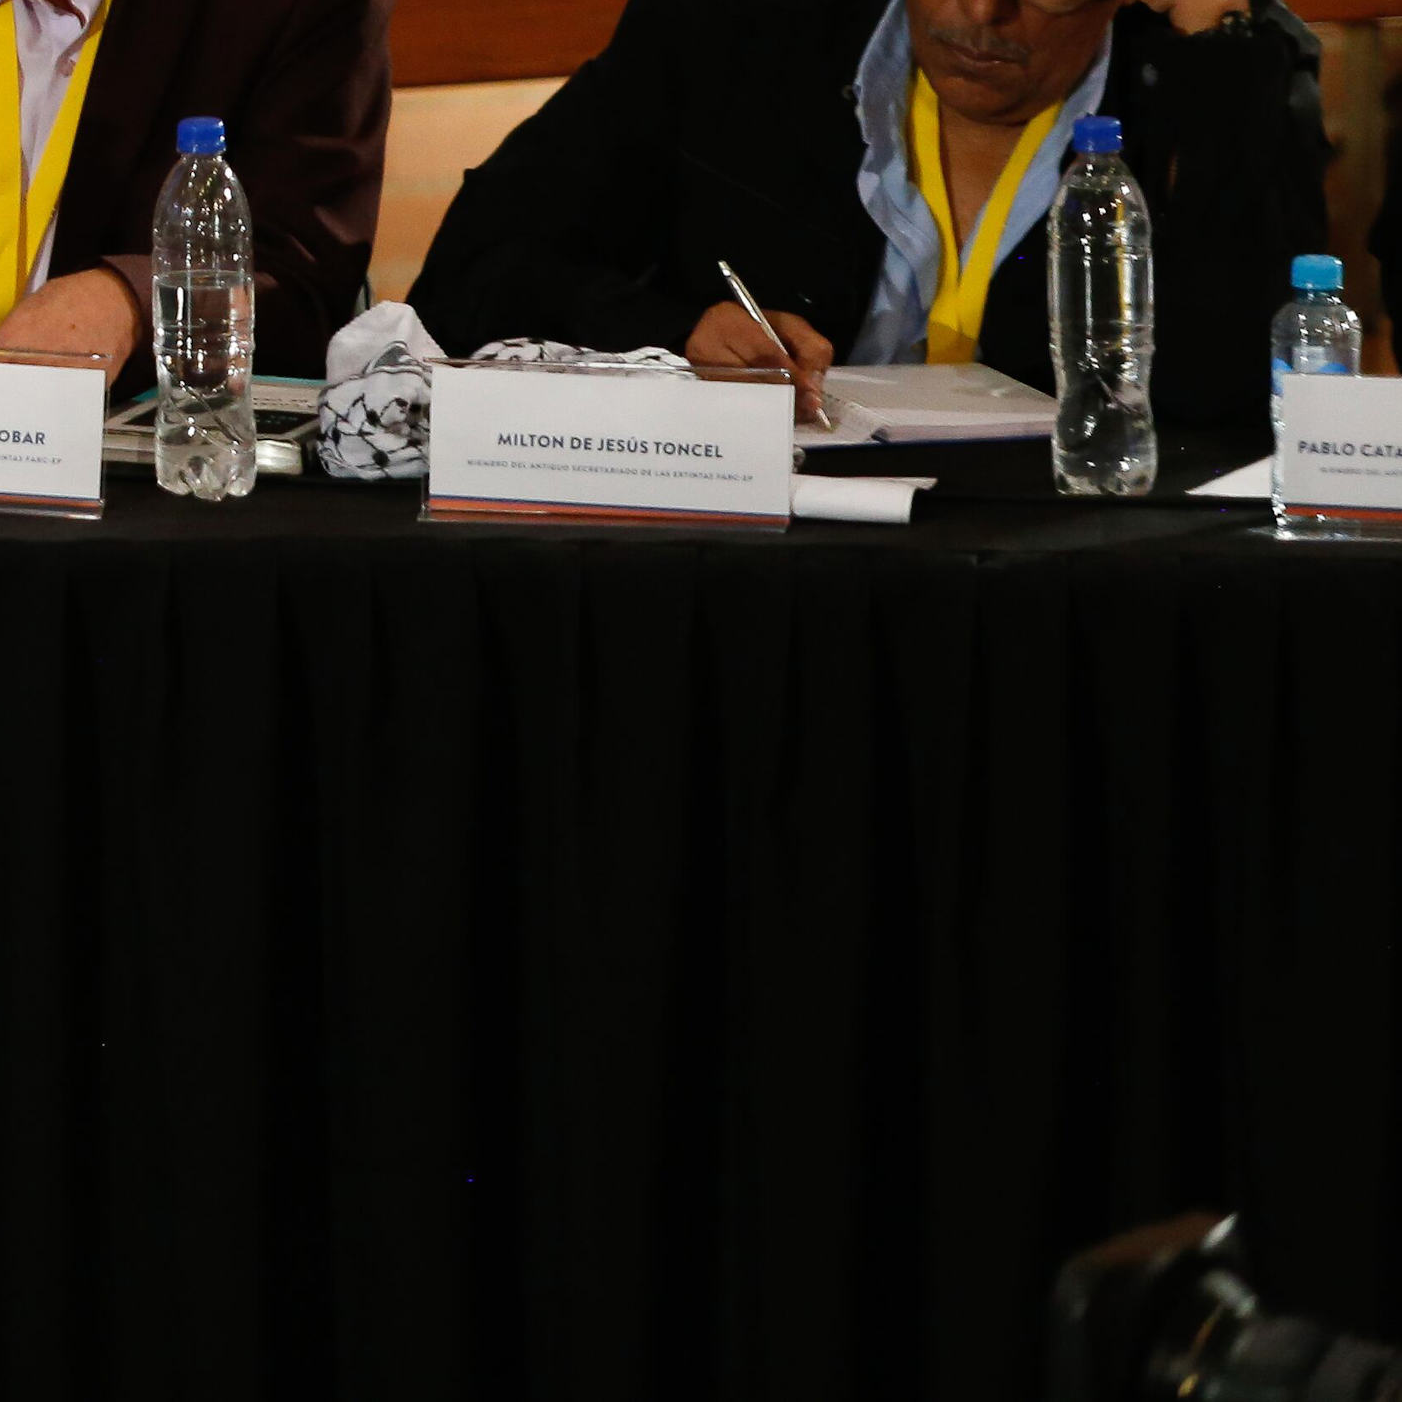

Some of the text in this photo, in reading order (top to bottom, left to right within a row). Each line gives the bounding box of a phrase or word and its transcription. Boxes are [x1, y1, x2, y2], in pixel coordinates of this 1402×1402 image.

[497, 433, 724, 458] MILTON DE JESÚS TONCEL
[1298, 440, 1356, 457] PABLO
[511, 461, 527, 469] DEL
